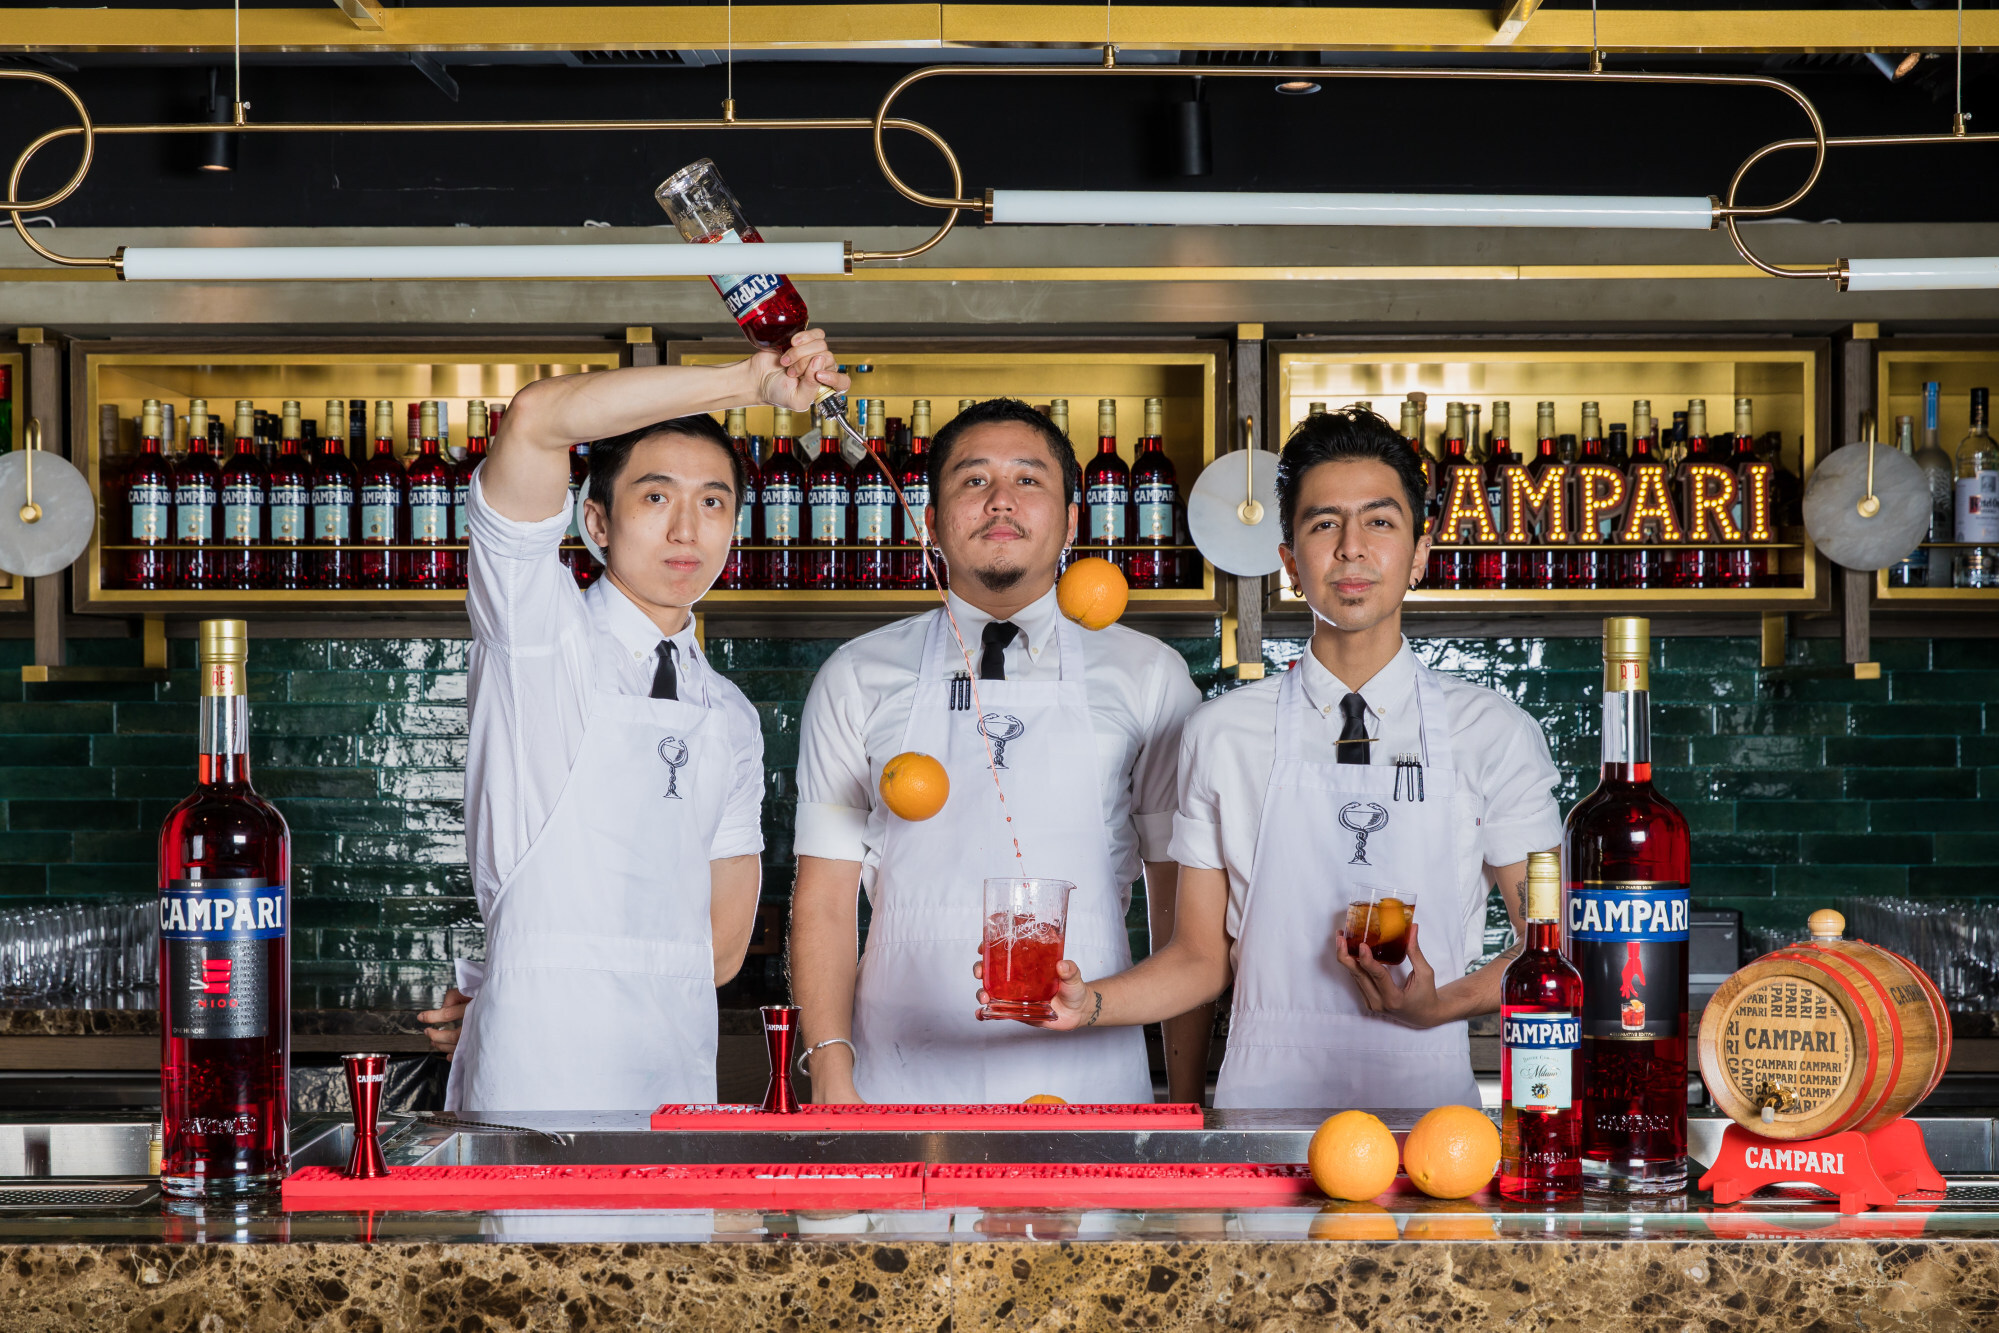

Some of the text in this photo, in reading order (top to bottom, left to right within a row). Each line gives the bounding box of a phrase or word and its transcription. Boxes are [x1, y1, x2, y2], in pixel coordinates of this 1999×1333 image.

[129, 490, 171, 504] CAMPARI
[175, 491, 216, 504] CAMPARI
[222, 491, 264, 504] CAMPARI
[268, 491, 309, 504] CAMPARI
[312, 491, 353, 504] CAMPARI
[361, 491, 400, 504] AMPARI
[409, 491, 450, 504] CAMPARI
[762, 490, 803, 503] CAMPARI
[808, 491, 849, 504] CAMPARI
[854, 490, 896, 503] CAMPARI
[1086, 490, 1129, 503] CAMPARI
[1134, 489, 1175, 503] CAMPAR
[1421, 459, 1774, 544] AMPARI
[1620, 664, 1640, 680] RD
[160, 895, 282, 932] CAMPARI
[1569, 897, 1689, 933] CAMPARI
[1503, 1021, 1579, 1045] CAMPARI
[1745, 1027, 1837, 1053] CAMPARI
[1755, 1058, 1842, 1073] CAMPARI CAMPARI
[1741, 1058, 1753, 1098] CAMP
[1800, 1074, 1842, 1086] CAMPARI
[1745, 1146, 1845, 1175] CAMPARI
